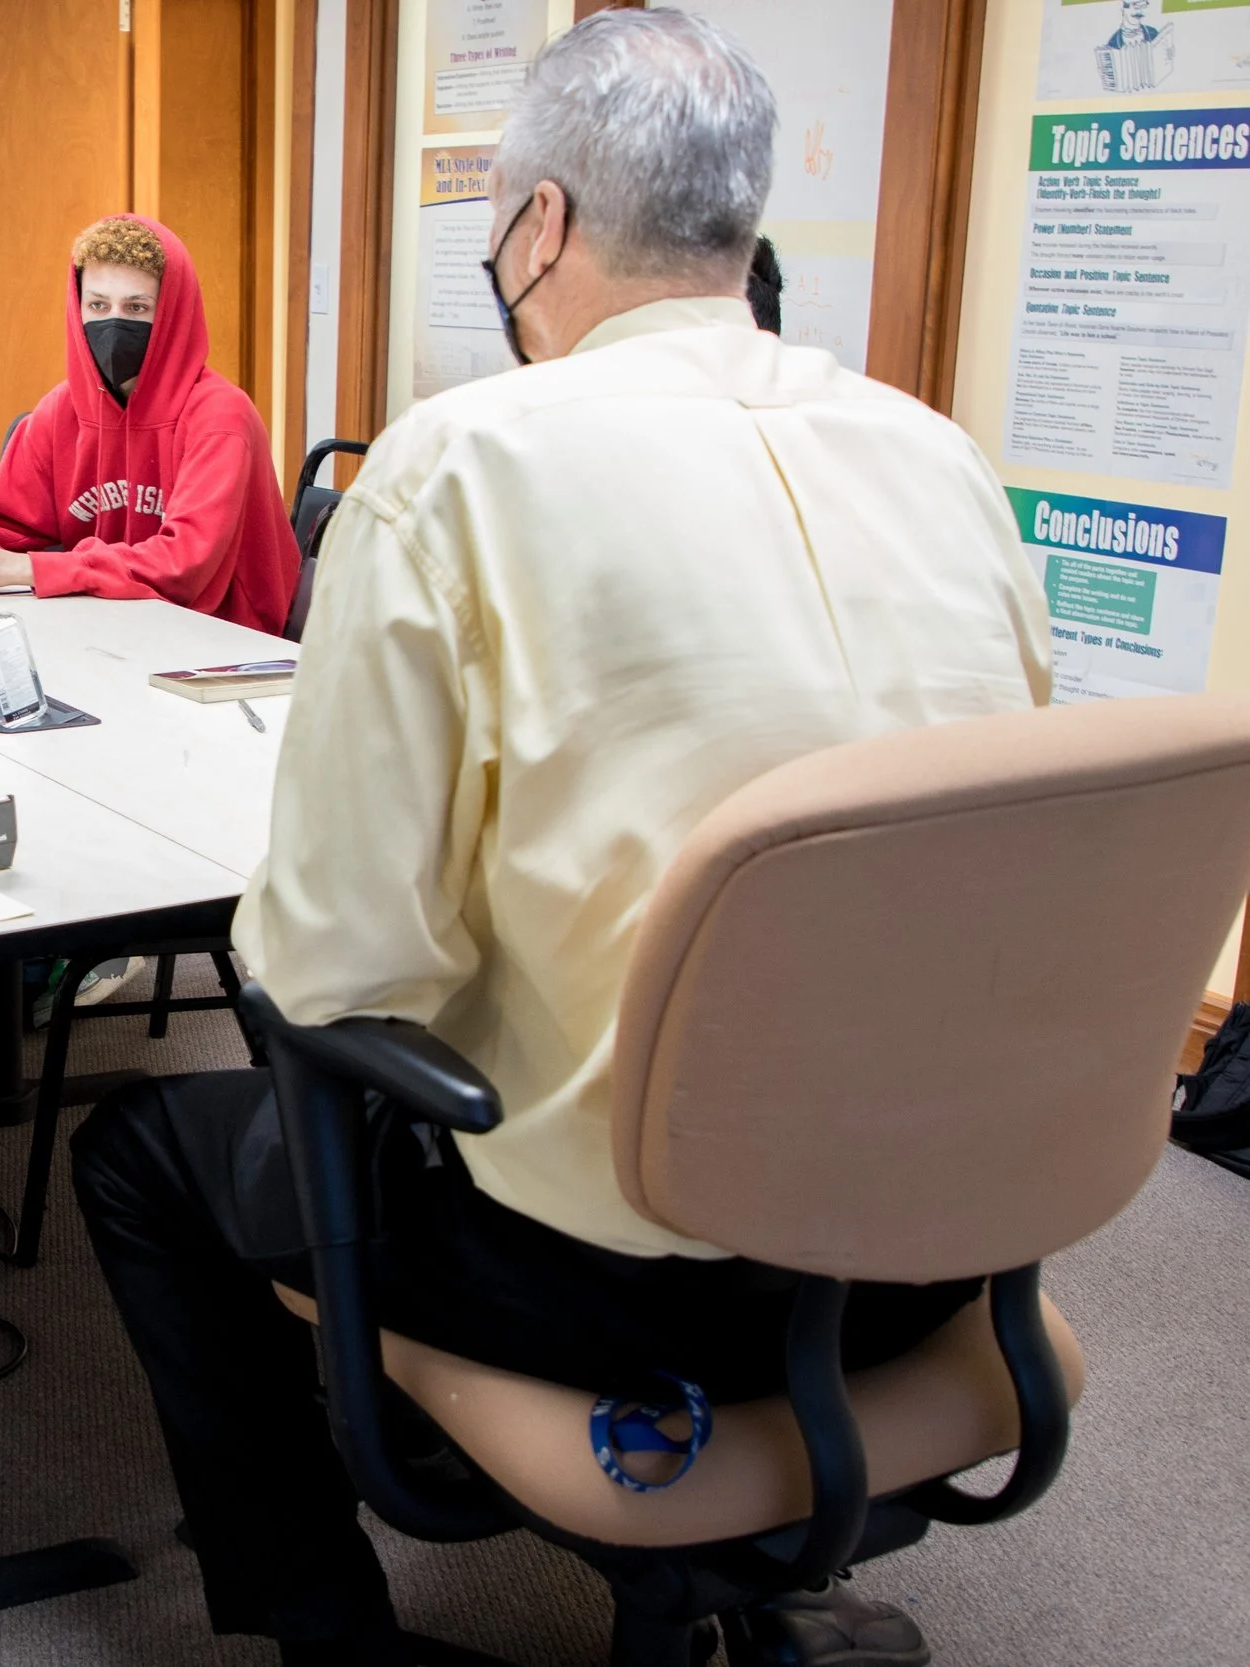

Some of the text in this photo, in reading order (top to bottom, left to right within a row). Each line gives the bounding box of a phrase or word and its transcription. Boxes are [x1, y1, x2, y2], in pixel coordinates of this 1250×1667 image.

[1051, 119, 1250, 167] Topic Sentences
[435, 159, 452, 174] MLA
[454, 159, 473, 174] Style
[436, 177, 486, 193] and In-Text
[1063, 176, 1080, 187] Verb
[1083, 176, 1101, 188] Topic
[1104, 176, 1139, 187] Sentence
[1113, 188, 1125, 200] the
[1033, 224, 1055, 234] Power
[1094, 224, 1132, 236] Statement
[1029, 268, 1170, 284] Occasion and Position Topic Sentence
[1061, 303, 1079, 315] Topic
[1082, 304, 1117, 317] Sentence
[1034, 500, 1180, 561] Conclusions
[1051, 625, 1164, 659] fferent Types of Conclusions:
